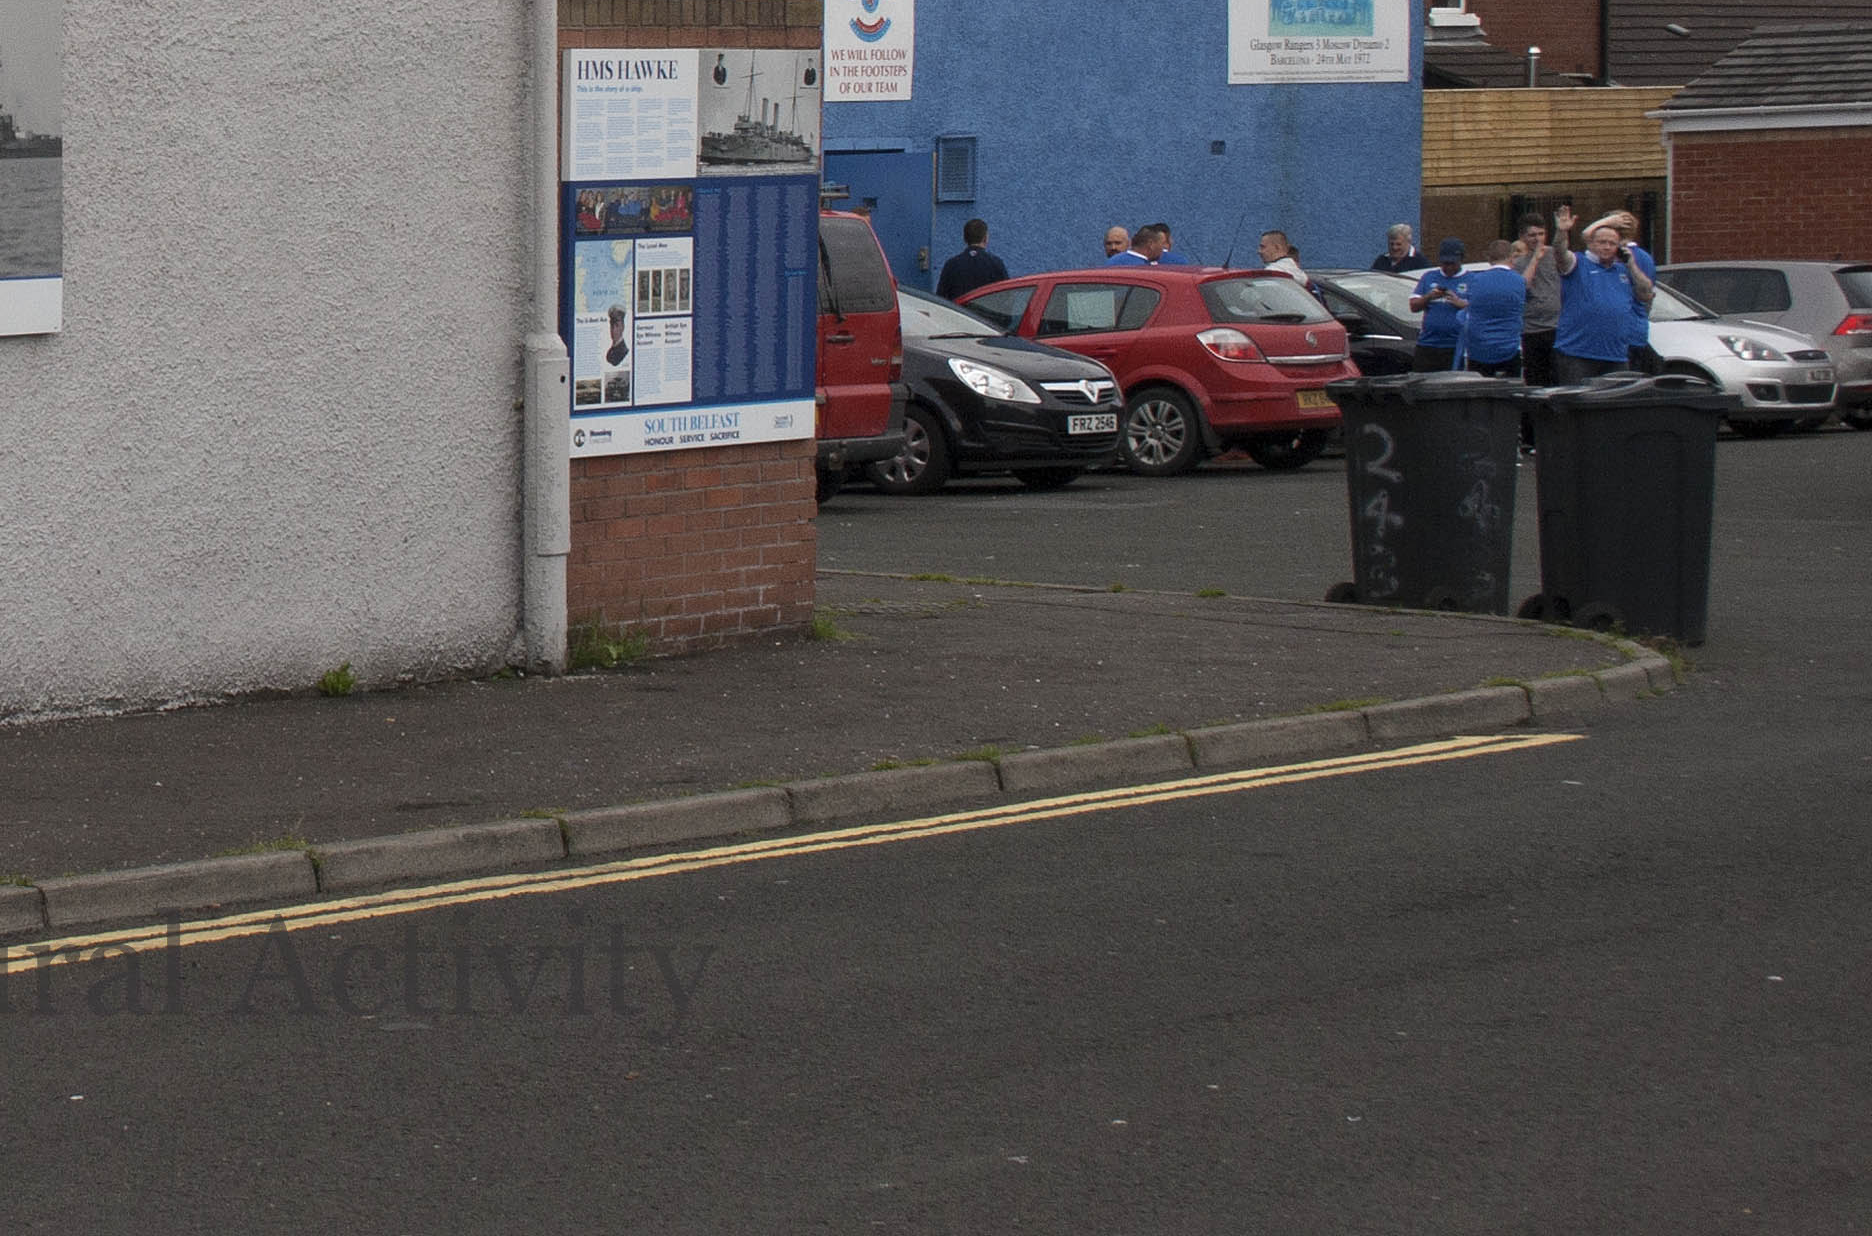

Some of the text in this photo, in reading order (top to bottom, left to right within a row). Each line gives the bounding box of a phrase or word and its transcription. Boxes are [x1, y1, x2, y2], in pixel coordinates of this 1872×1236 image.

[831, 49, 908, 61] WE WILL FOLLOW
[576, 60, 679, 80] HMS HAWKE
[830, 65, 908, 77] IN THE FOOTSTEPS
[839, 82, 899, 94] OF OUR TEAM
[644, 411, 741, 434] SOUTH BELFAST
[644, 430, 740, 447] HONOUR SERVICE SACRIFICE
